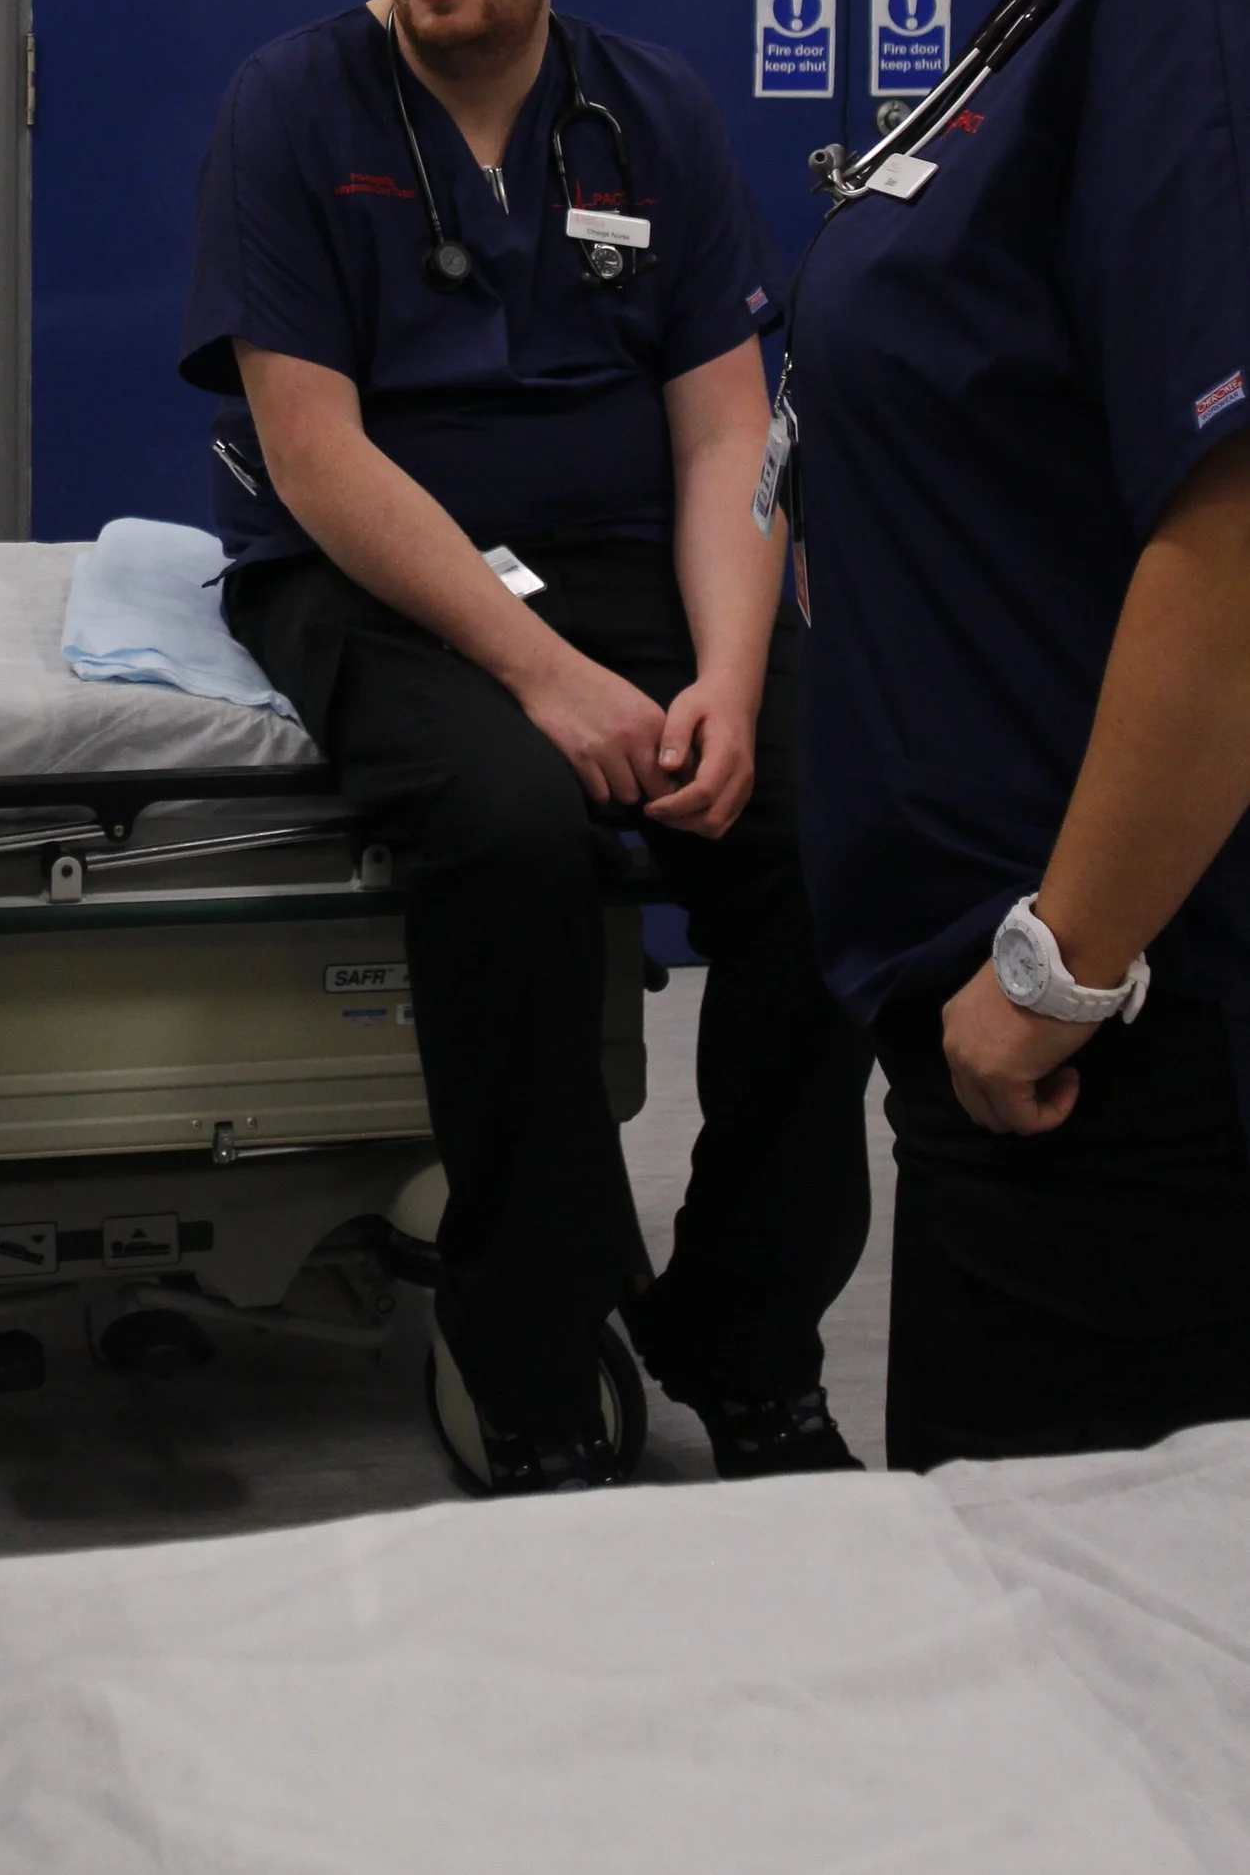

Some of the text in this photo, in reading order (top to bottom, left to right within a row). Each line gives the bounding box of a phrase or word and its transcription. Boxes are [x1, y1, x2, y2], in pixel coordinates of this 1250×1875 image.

[767, 43, 825, 56] Fire door
[883, 42, 940, 55] Fire door
[765, 59, 827, 74] keep shut
[881, 58, 942, 73] keep shut
[593, 191, 626, 206] PAC
